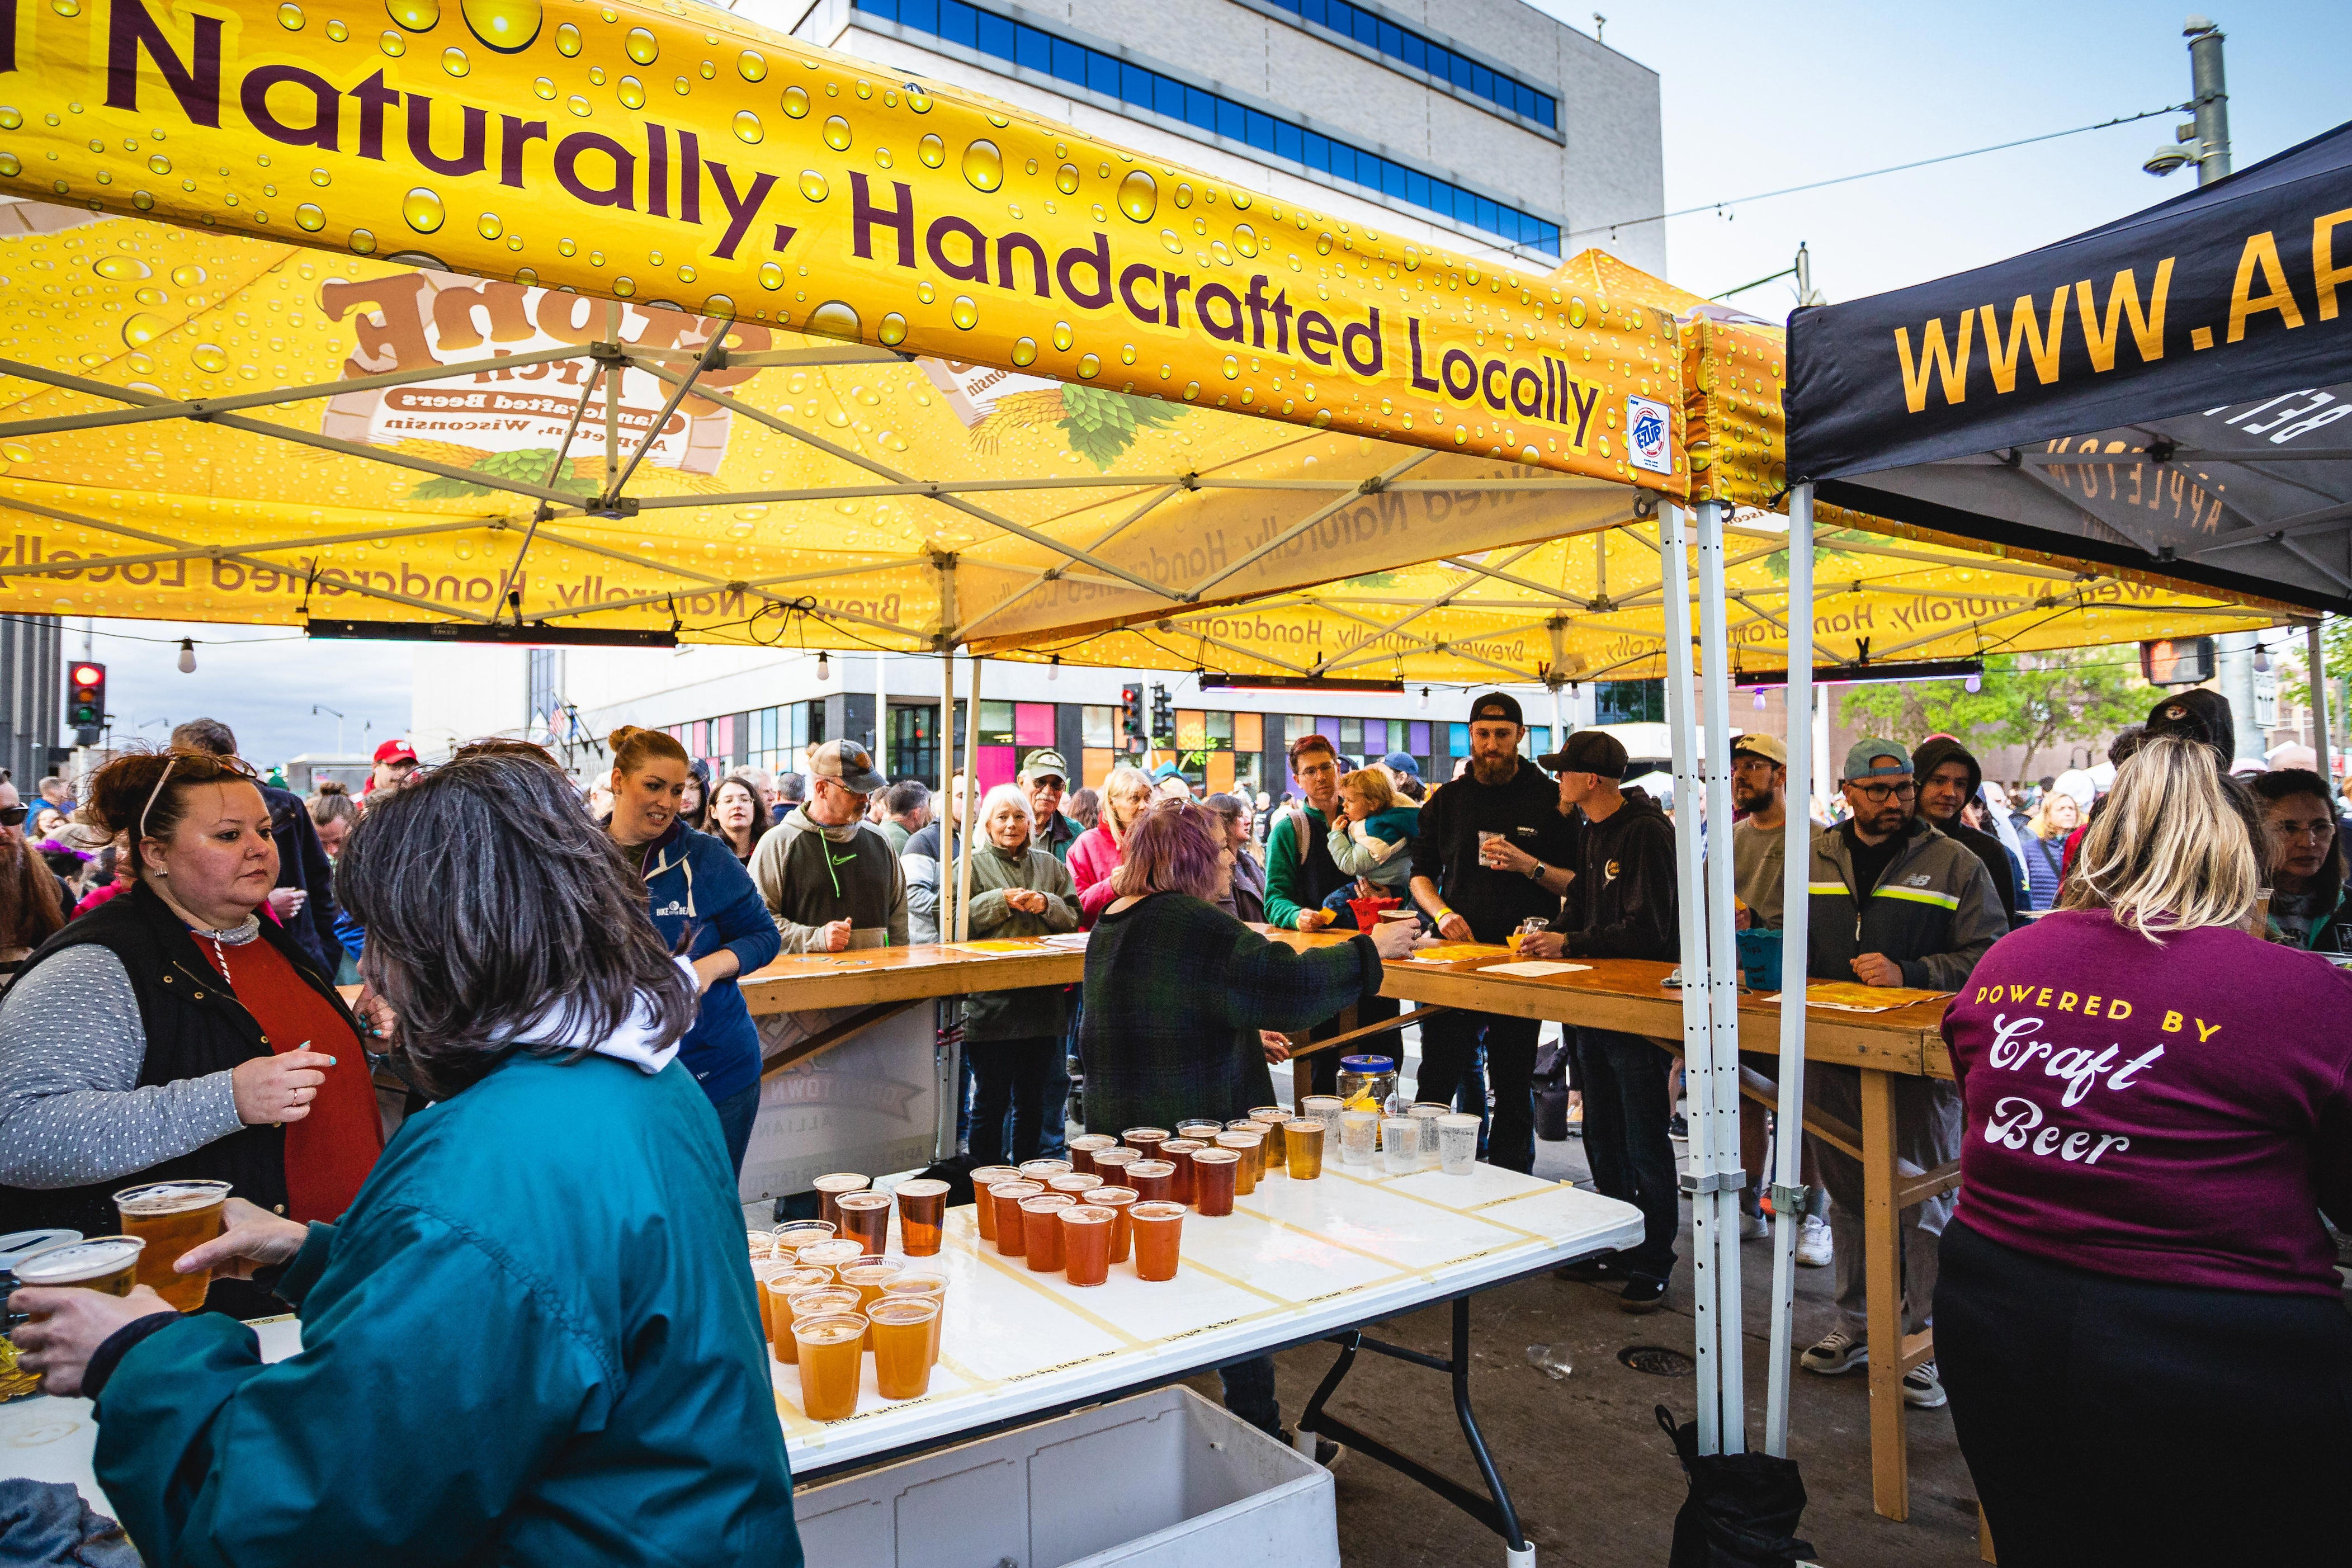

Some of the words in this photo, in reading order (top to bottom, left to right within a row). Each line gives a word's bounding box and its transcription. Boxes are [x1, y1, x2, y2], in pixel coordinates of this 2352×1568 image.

[103, 0, 798, 261] Naturally,
[848, 170, 1384, 376] Handcrafted
[1408, 317, 1599, 447] Locally
[657, 908, 669, 916] BIKE
[679, 906, 688, 915] BEA
[1975, 985, 2132, 1020] POWERED
[2162, 1011, 2222, 1042] BY
[1989, 1013, 2165, 1108] Craft
[1984, 1097, 2129, 1165] Beer
